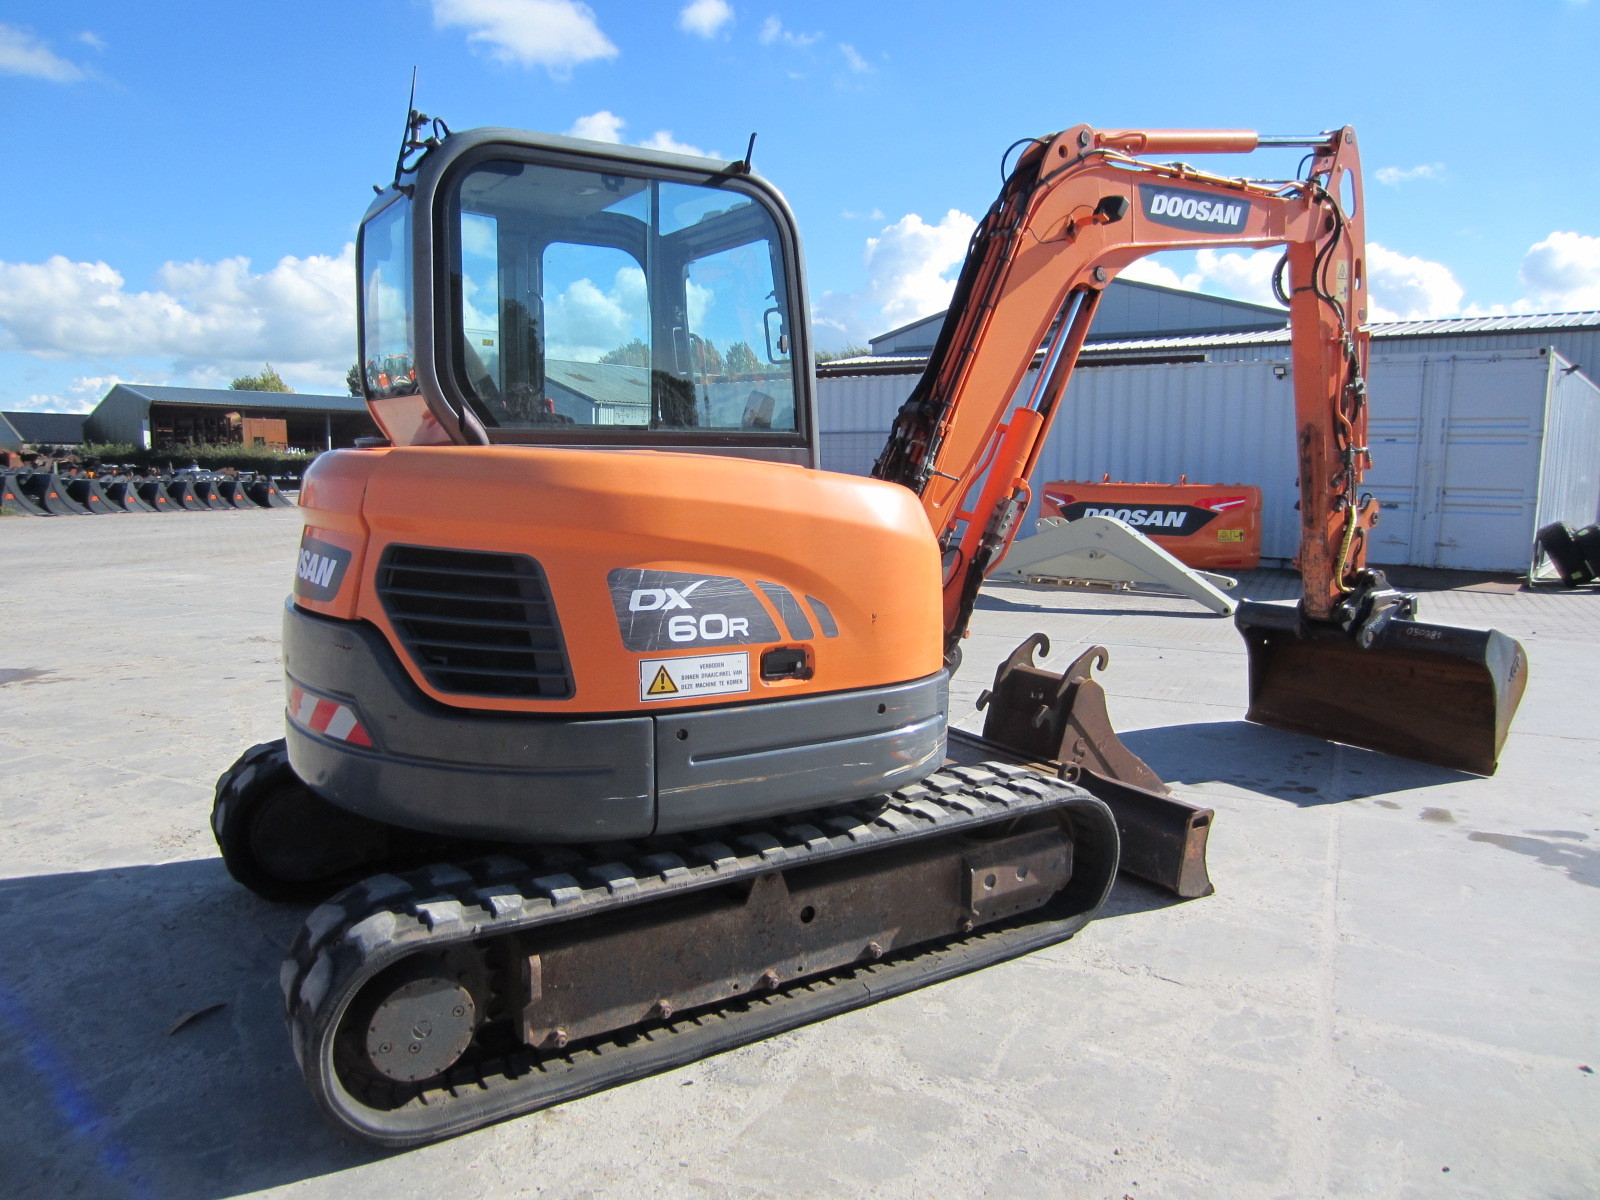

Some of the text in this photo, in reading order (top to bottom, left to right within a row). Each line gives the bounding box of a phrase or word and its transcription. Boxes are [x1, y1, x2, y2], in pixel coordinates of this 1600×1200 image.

[1150, 194, 1241, 226] DOOSAN
[629, 579, 708, 612] DX
[668, 613, 749, 642] 60R
